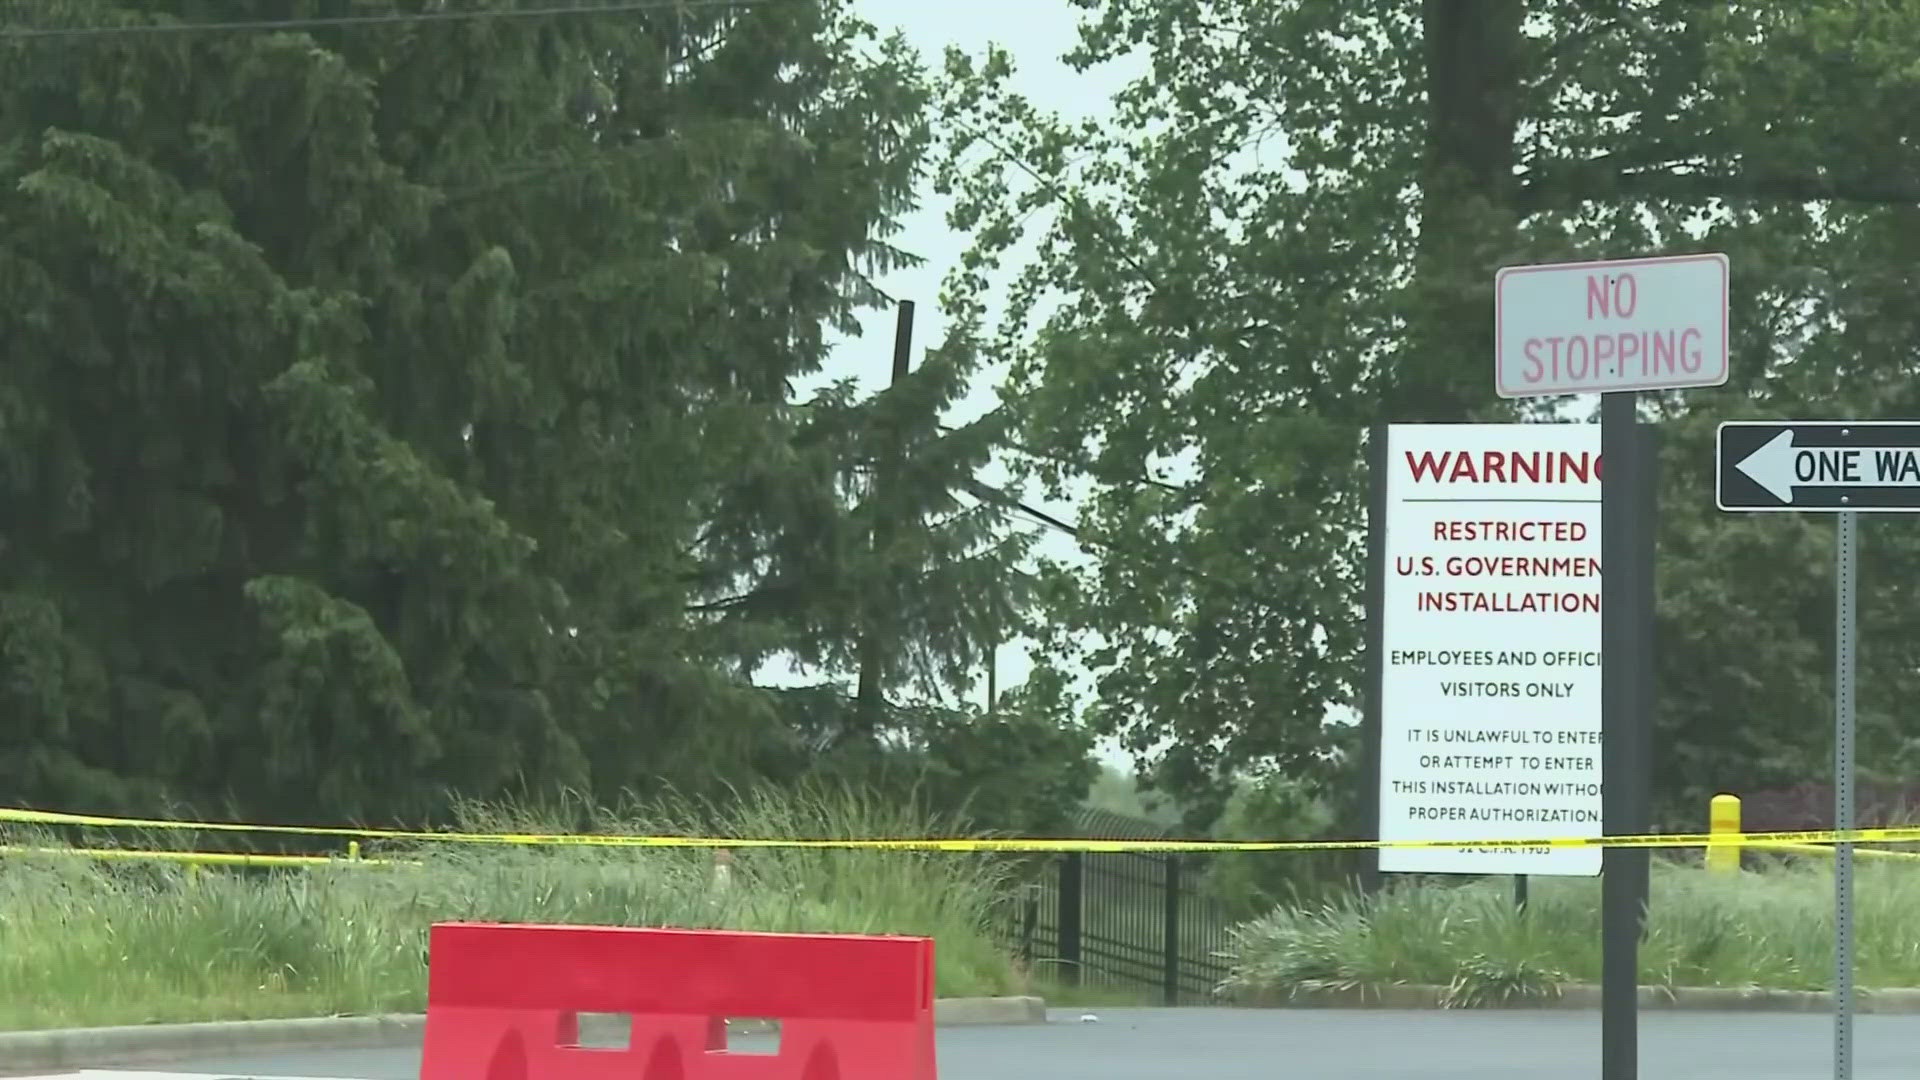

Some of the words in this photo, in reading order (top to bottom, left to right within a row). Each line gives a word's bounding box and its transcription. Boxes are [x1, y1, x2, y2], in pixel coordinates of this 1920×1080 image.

[1587, 272, 1638, 321] NO
[1522, 327, 1702, 384] STOPPING
[1405, 450, 1603, 484] WARNIN
[1795, 450, 1861, 482] ONE
[1434, 521, 1587, 542] RESTRICTED
[1396, 556, 1440, 577] U.S.
[1417, 592, 1601, 613] INSTALLATION
[1391, 650, 1494, 666] EMPLOYEES
[1497, 651, 1537, 667] AND
[1440, 682, 1521, 698] VISITORS
[1525, 682, 1574, 698] ONLY
[1407, 729, 1422, 743] IT
[1426, 730, 1440, 743] IS
[1444, 730, 1530, 744] UNLAWFUL
[1533, 731, 1553, 745] TO
[1419, 755, 1441, 769] OR
[1443, 756, 1514, 770] ATTEMPT
[1521, 757, 1541, 771] TO
[1544, 757, 1594, 771] ENTER
[1392, 781, 1427, 795] THIS
[1431, 782, 1542, 797] INSTALLATION
[1409, 807, 1467, 821] PROPER
